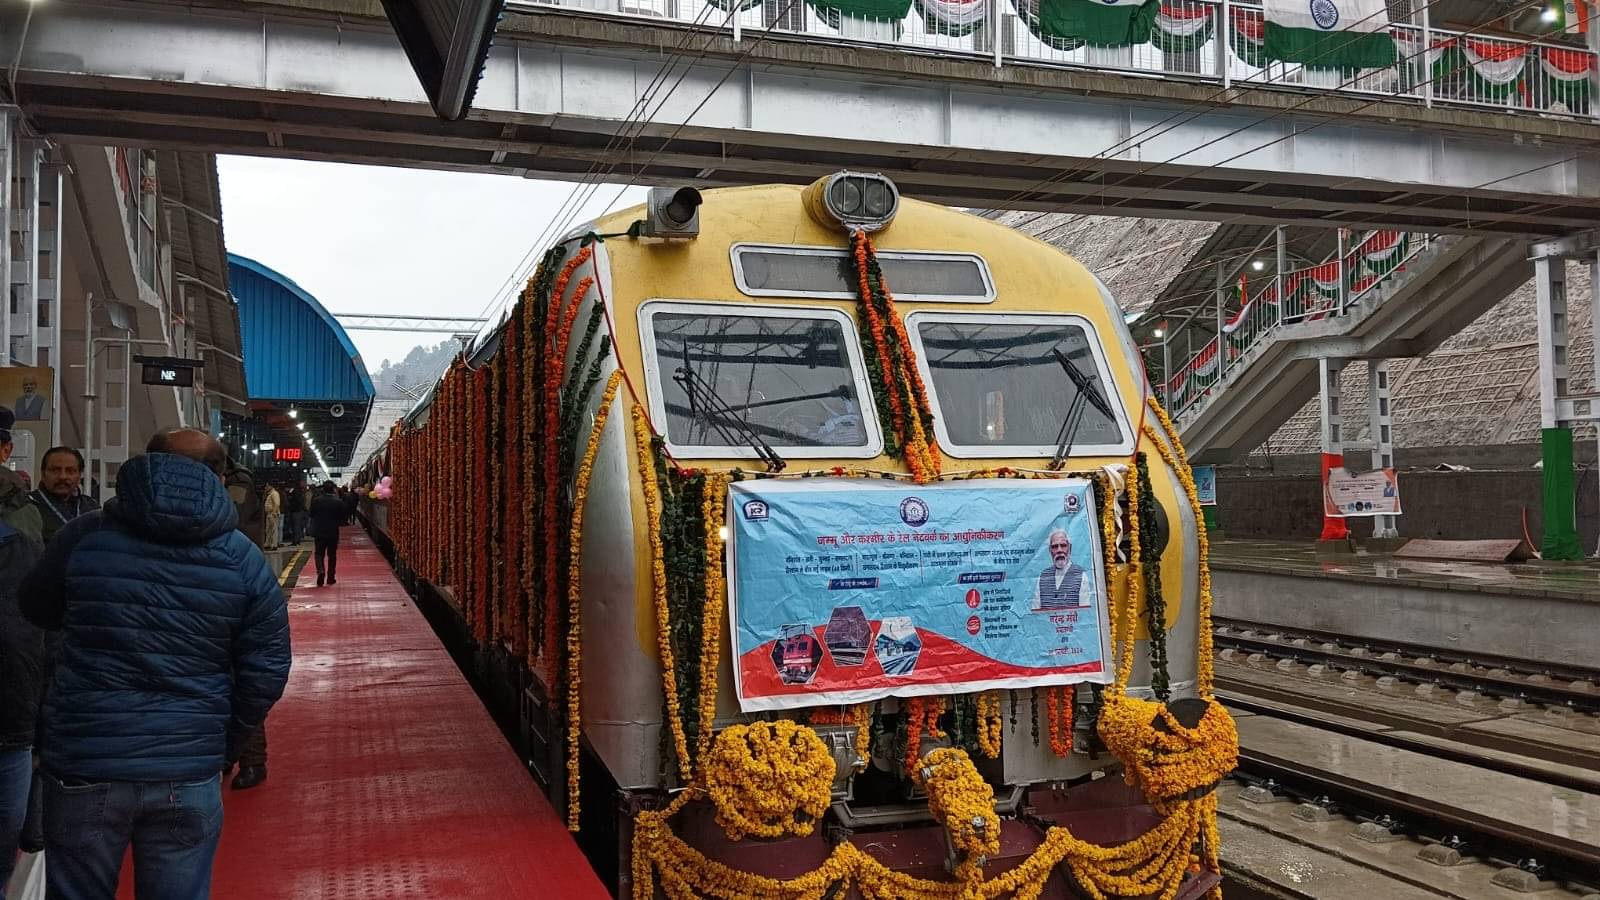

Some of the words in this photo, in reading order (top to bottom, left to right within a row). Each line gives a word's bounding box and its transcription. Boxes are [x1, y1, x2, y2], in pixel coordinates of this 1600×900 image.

[816, 535, 840, 548] जम्मू
[841, 531, 856, 545] और
[858, 531, 885, 544] कश्मीर
[887, 531, 896, 543] के
[939, 533, 950, 542] का
